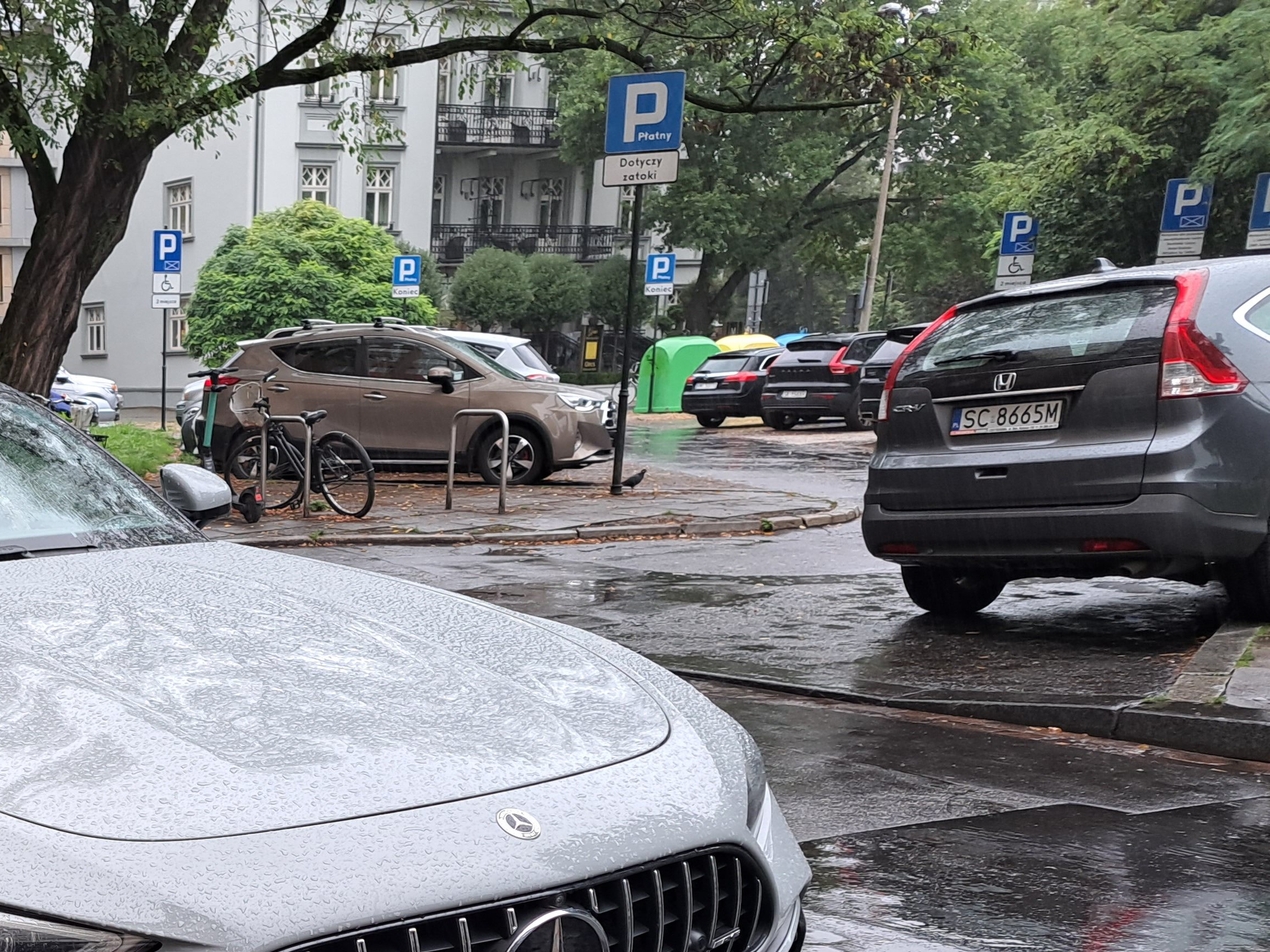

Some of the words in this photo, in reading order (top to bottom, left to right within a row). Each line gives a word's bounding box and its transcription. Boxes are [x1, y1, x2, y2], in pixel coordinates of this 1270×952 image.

[623, 81, 668, 143] P
[638, 131, 672, 142] Płatny
[619, 157, 663, 169] Dotyczy
[622, 170, 657, 181] zatoki
[1173, 183, 1203, 216] P
[1010, 215, 1033, 243] P
[159, 233, 177, 261] P
[399, 258, 416, 282] P
[652, 256, 670, 280] P
[393, 288, 418, 296] Koniec
[645, 285, 672, 293] Koniec
[963, 409, 991, 429] SC
[996, 402, 1060, 426] 8665M
